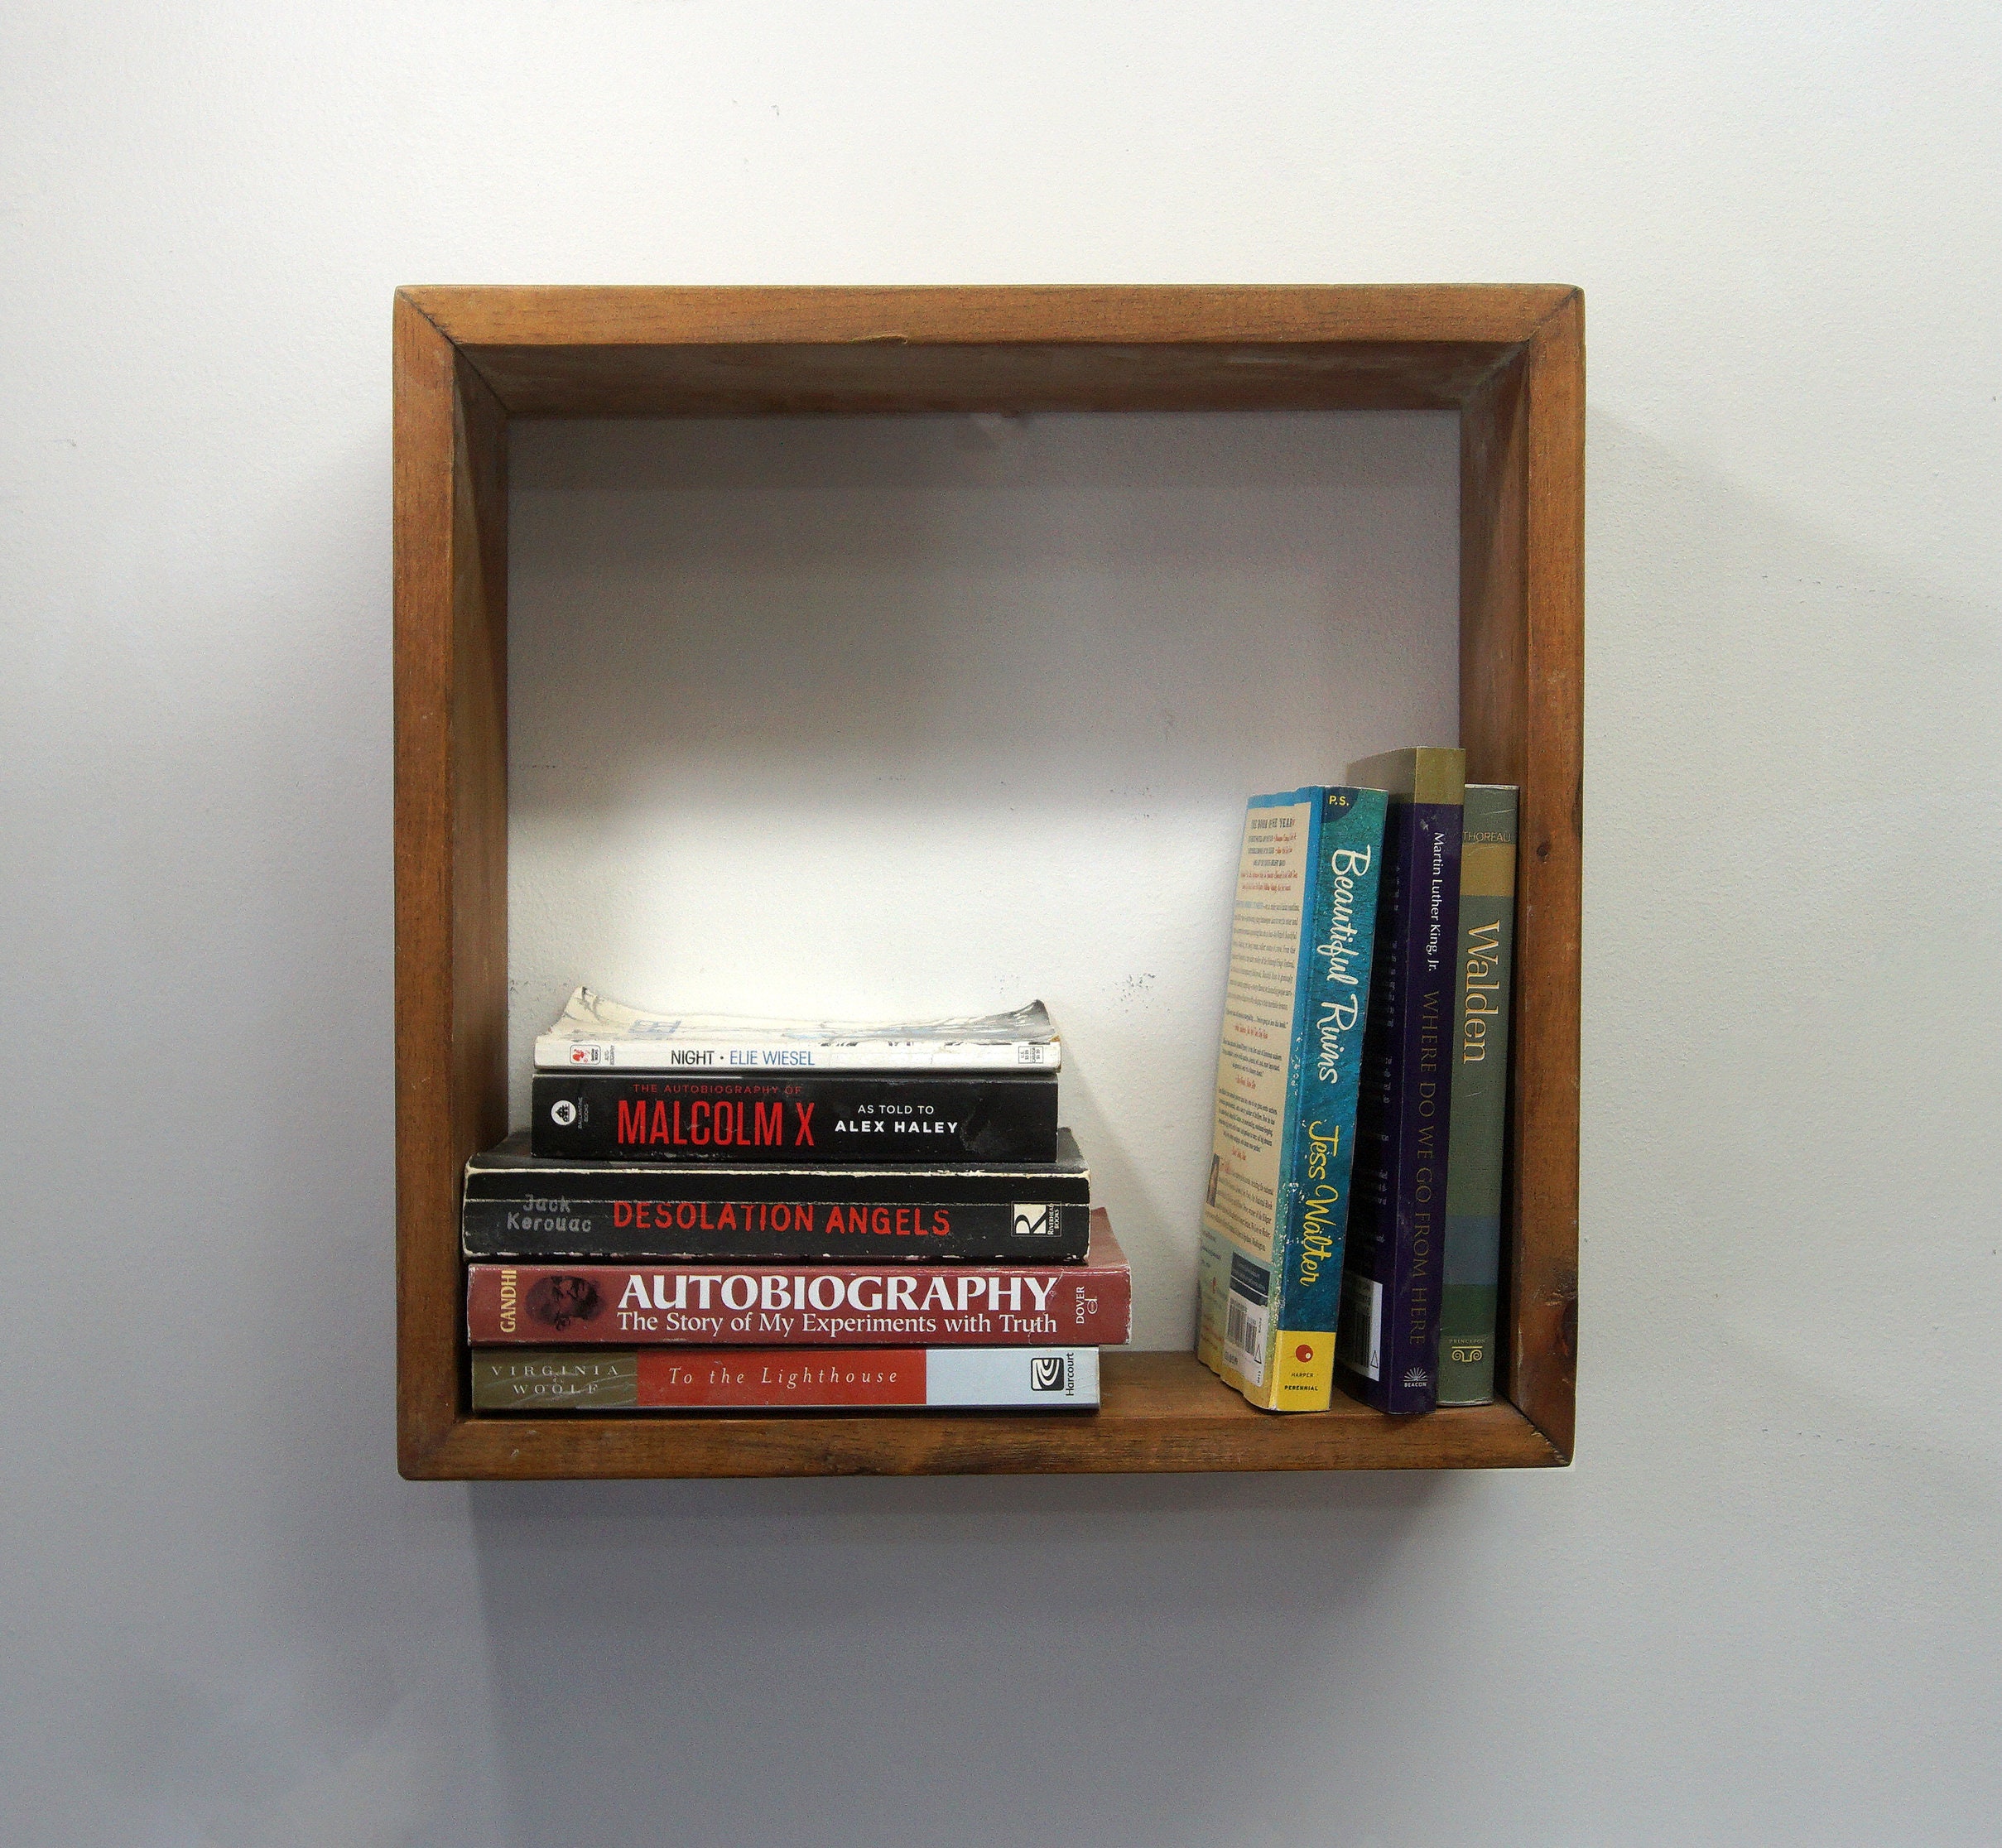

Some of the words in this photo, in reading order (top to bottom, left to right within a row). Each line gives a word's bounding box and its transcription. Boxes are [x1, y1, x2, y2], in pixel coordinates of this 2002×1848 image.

[1329, 796, 1349, 806] P.S.
[1463, 830, 1511, 842] THOREAU
[1432, 832, 1445, 876] Martin
[1317, 845, 1371, 985] Beautiful
[1432, 879, 1443, 921] Luther
[1426, 924, 1441, 955] King,
[1427, 960, 1437, 971] Jr.
[1464, 920, 1500, 1064] Walden
[1316, 994, 1358, 1084] Ruins
[1421, 991, 1439, 1073] WHERE
[671, 1050, 714, 1065] NIGHT
[730, 1051, 758, 1065] ELIE
[763, 1051, 815, 1065] WIESEL
[633, 1084, 657, 1094] THE
[664, 1085, 778, 1095] AUTOBIOGRAPHY
[784, 1085, 801, 1095] OF
[1418, 1082, 1436, 1117] DO
[618, 1100, 782, 1146] MALCOLM
[795, 1101, 815, 1146] X
[858, 1104, 873, 1114] AS
[879, 1105, 912, 1114] TOLD
[917, 1105, 934, 1114] TO
[835, 1121, 884, 1133] ALEX
[894, 1122, 958, 1133] HALEY
[1417, 1127, 1434, 1159] WE
[1307, 1119, 1340, 1180] Jess
[1415, 1168, 1433, 1203] GO
[523, 1195, 570, 1213] Jack
[613, 1201, 814, 1233] DESOLATION
[825, 1207, 950, 1235] ANGELS
[507, 1212, 591, 1233] Kerouac
[1299, 1184, 1339, 1287] Walter
[1412, 1213, 1431, 1278] FROM
[499, 1268, 517, 1332] GANDHI
[618, 1273, 1057, 1311] AUTOBIOGRAPHY
[1076, 1286, 1085, 1324] DOVER
[617, 1311, 658, 1331] The
[667, 1312, 723, 1337] Story
[730, 1312, 751, 1331] of
[758, 1311, 795, 1336] My
[802, 1314, 936, 1337] Experiments
[945, 1315, 991, 1332] with
[999, 1315, 1057, 1333] Truth
[1408, 1287, 1427, 1345] HERE
[491, 1366, 619, 1376] VIRGINIA
[669, 1367, 692, 1384] To
[710, 1367, 744, 1383] the
[761, 1366, 898, 1391] Lighthouse
[1066, 1352, 1074, 1396] Harcourt
[513, 1384, 598, 1394] WOOLF
